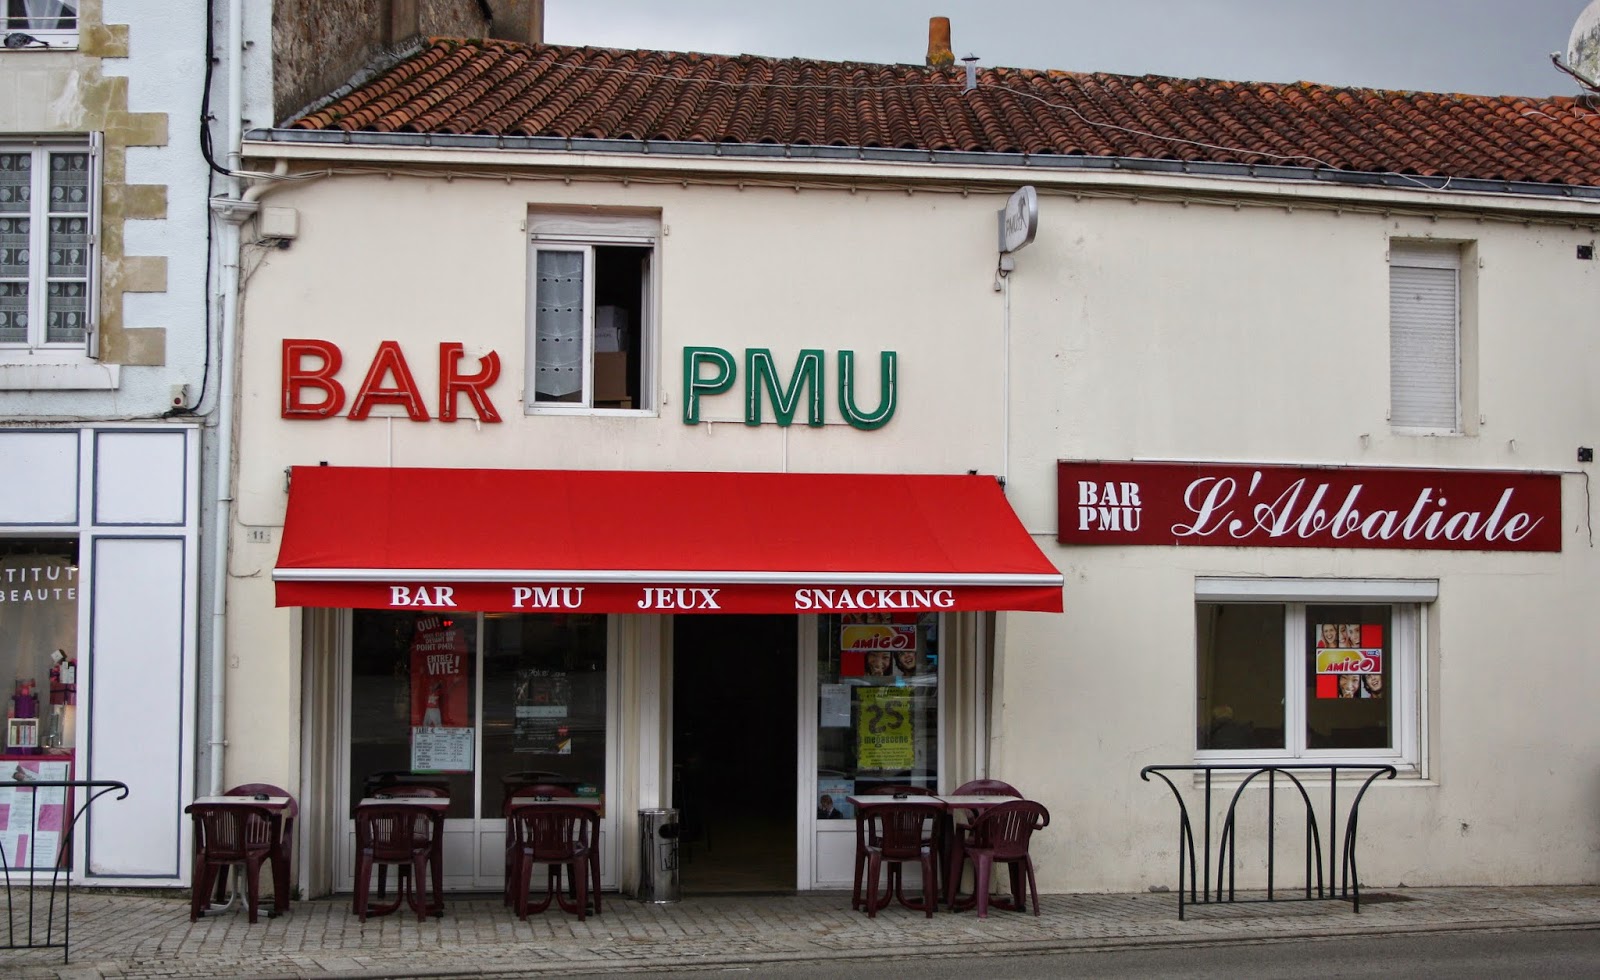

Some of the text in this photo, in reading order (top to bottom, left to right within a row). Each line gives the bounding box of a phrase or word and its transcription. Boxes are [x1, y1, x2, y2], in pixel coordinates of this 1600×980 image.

[281, 339, 503, 423] BAR
[683, 346, 897, 431] PMU
[1078, 481, 1142, 506] BAR
[1171, 471, 1545, 542] L'Abbatiale
[1078, 507, 1142, 532] PMU
[0, 566, 79, 583] TITUT
[390, 586, 955, 609] BAR PMU JEUX SNACKING
[417, 617, 440, 632] OUI!
[416, 643, 436, 652] POINT
[427, 654, 454, 664] ENTREZ
[428, 656, 460, 676] VITE!
